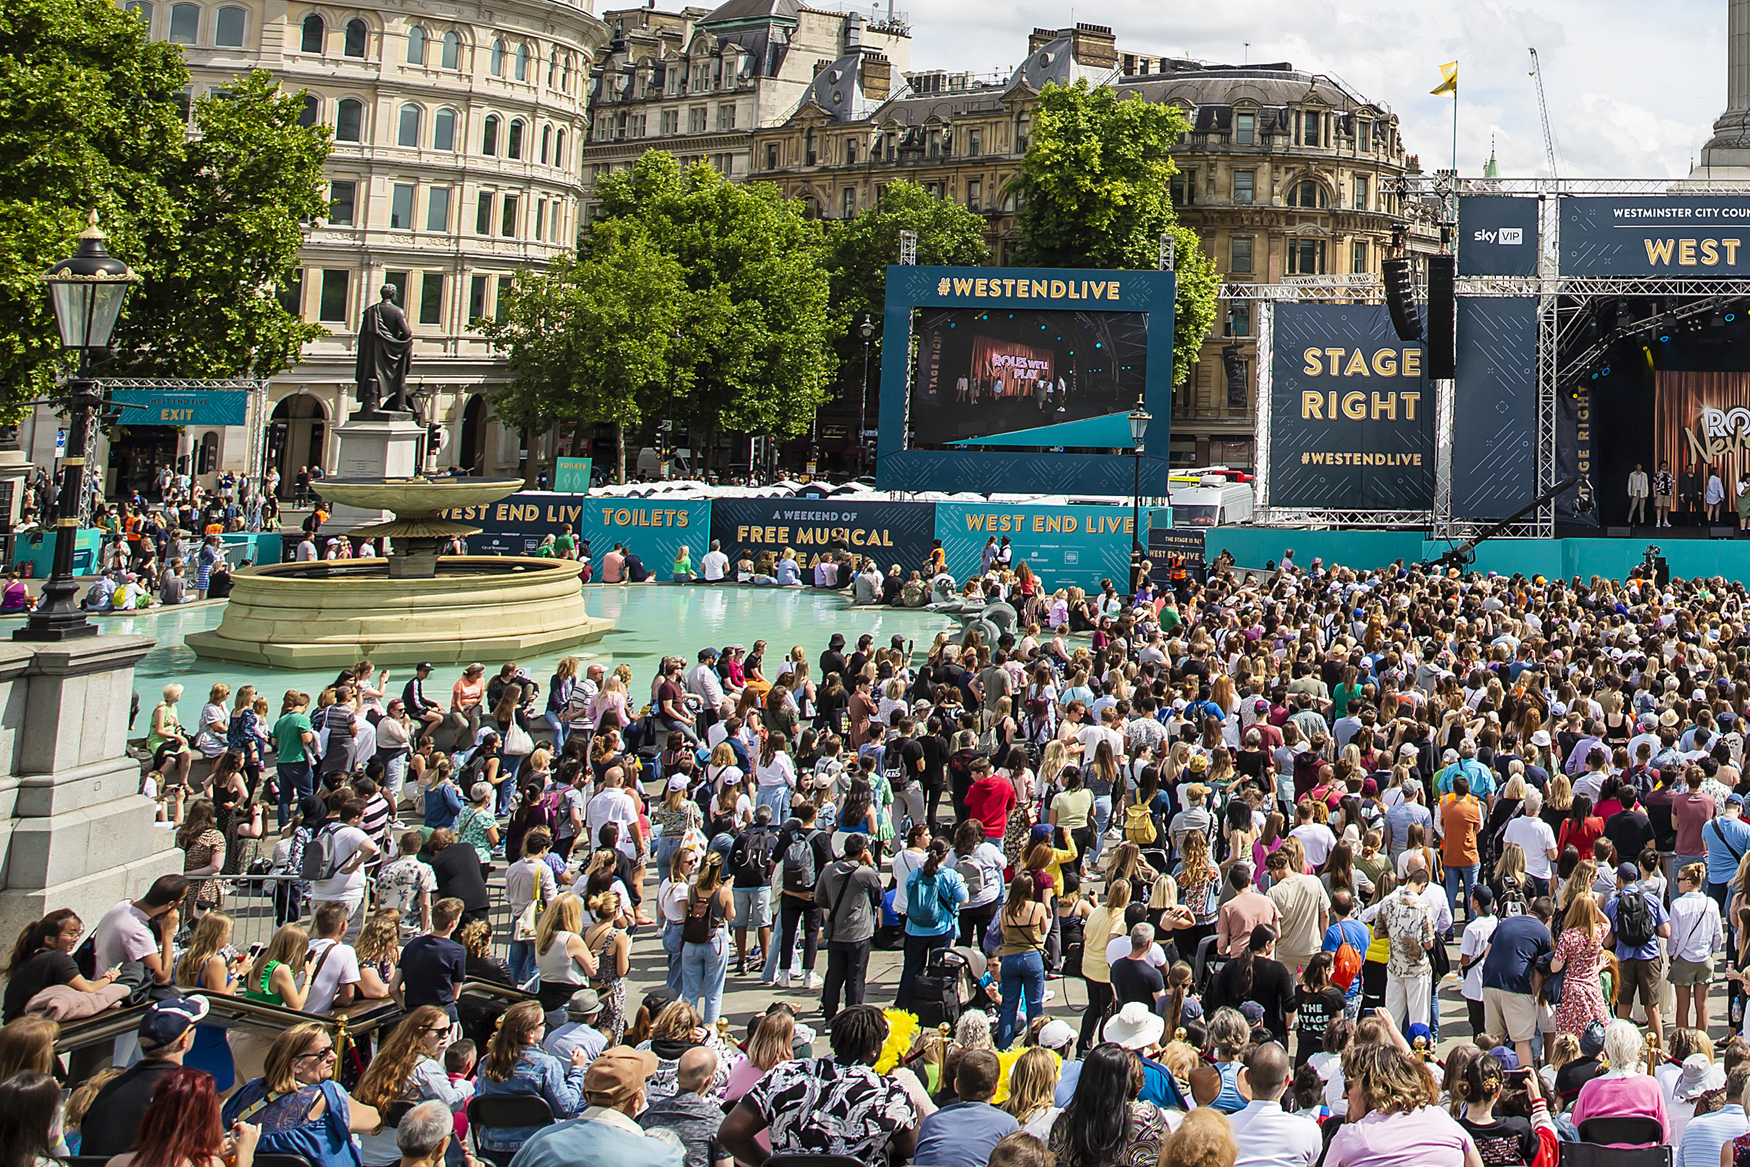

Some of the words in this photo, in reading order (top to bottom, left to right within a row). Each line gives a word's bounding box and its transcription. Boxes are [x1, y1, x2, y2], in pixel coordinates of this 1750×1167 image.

[1613, 208, 1692, 218] WESTMINSTER
[1695, 208, 1720, 218] CITY
[1474, 228, 1498, 244] sky
[1502, 231, 1520, 241] VIP
[1644, 238, 1742, 267] WEST
[937, 277, 1120, 302] #WESTENDLIVE
[1302, 347, 1422, 378] STAGE
[929, 364, 940, 395] STAGE
[1013, 368, 1039, 380] PLAY
[1301, 390, 1421, 421] RIGHT
[1577, 385, 1590, 441] RIGHT
[160, 408, 195, 421] EXIT
[560, 462, 587, 470] TOILETS
[1301, 451, 1422, 466] #WESTENDLIVE
[495, 503, 540, 522] END
[546, 505, 582, 522] LIV
[602, 507, 690, 528] TOILETS
[772, 510, 781, 520] A
[784, 510, 839, 522] WEEKEND
[841, 511, 858, 522] OF
[965, 513, 1026, 533] WEST
[1033, 516, 1078, 534] END
[1086, 517, 1134, 534] LIVE
[737, 525, 790, 544] FREE
[1149, 550, 1166, 558] WEST
[885, 767, 901, 778] VANS
[1301, 1003, 1323, 1013] THE
